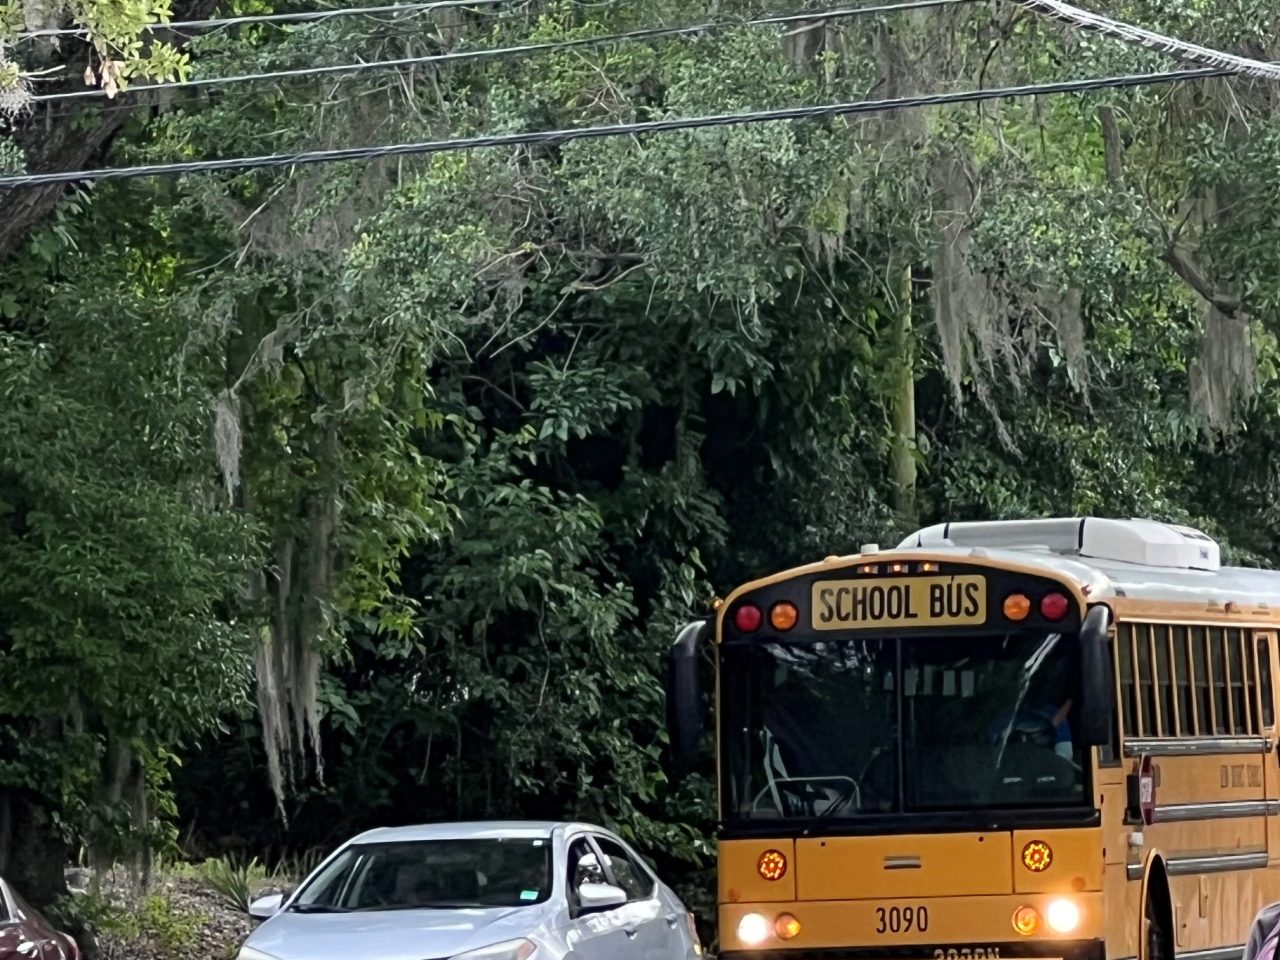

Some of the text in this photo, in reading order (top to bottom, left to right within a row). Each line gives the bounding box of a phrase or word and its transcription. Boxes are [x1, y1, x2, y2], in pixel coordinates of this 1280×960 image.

[819, 582, 980, 623] SCHOOL BUS
[875, 905, 929, 934] 3090
